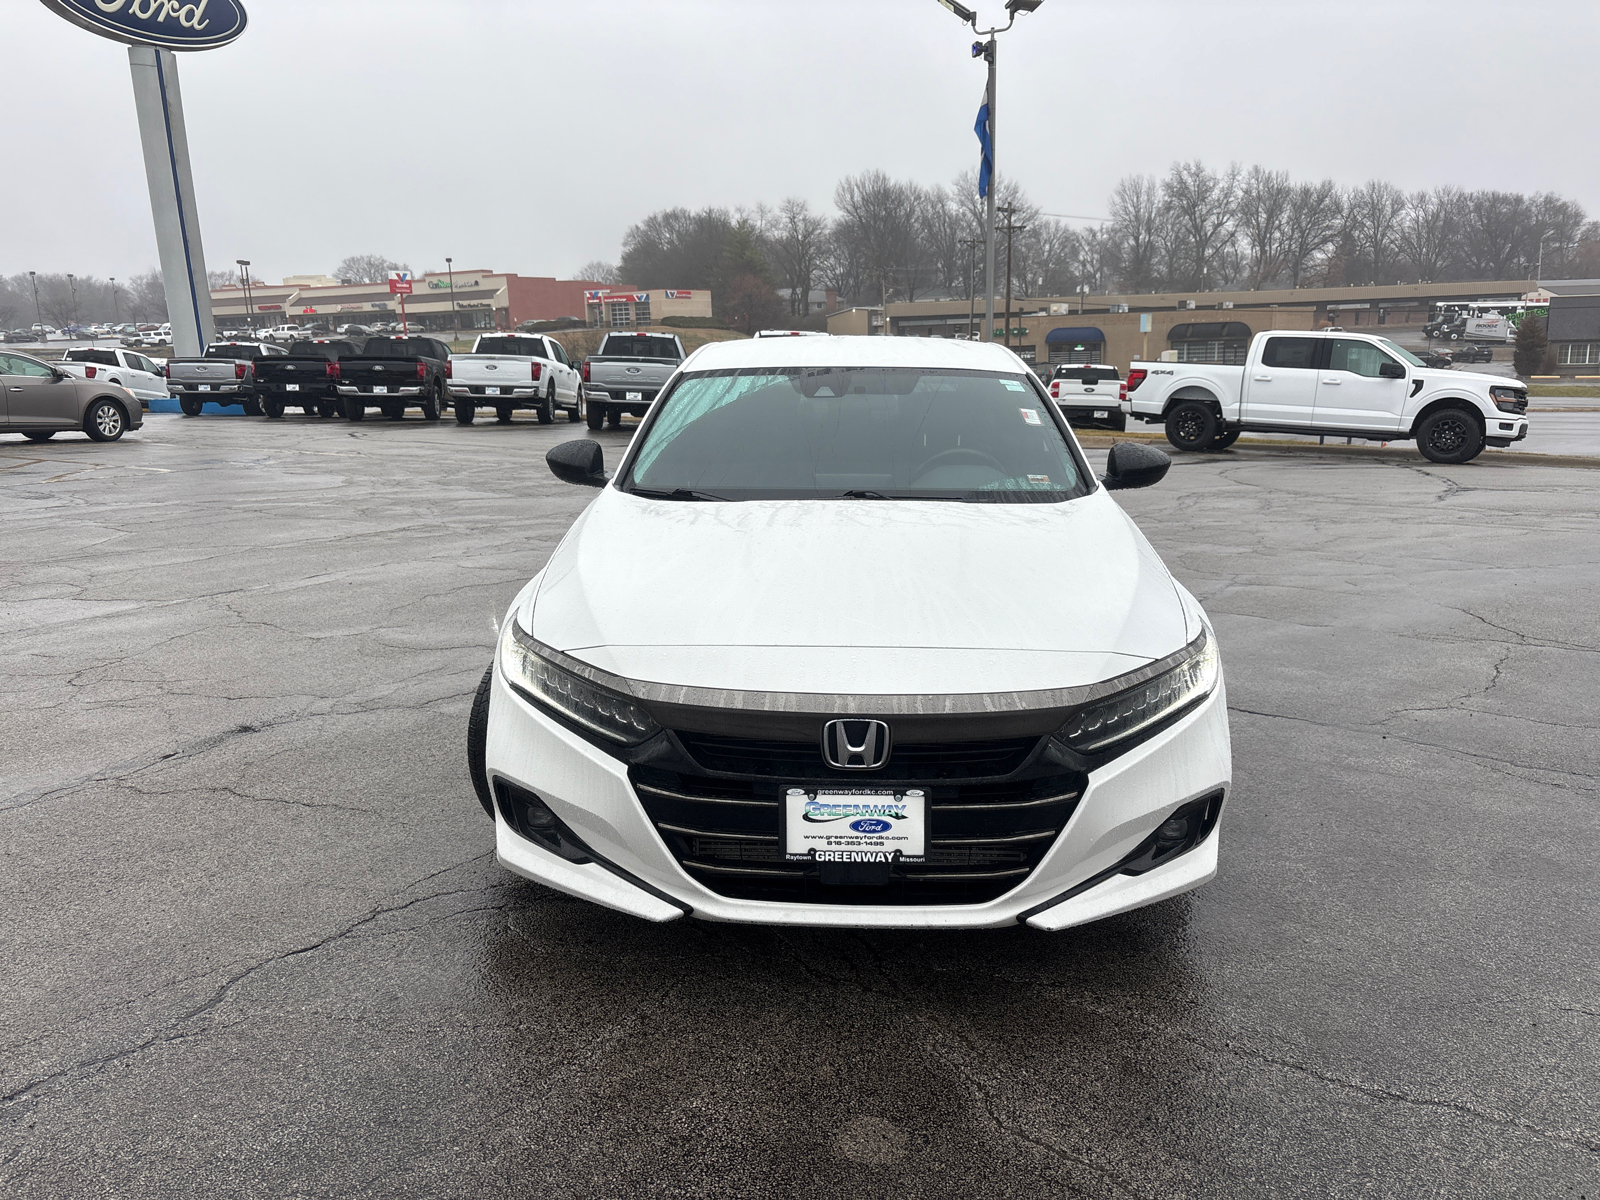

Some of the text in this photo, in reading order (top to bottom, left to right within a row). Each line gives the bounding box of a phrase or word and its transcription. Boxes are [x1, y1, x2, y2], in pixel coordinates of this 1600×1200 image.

[805, 801, 907, 817] GREENWAY
[858, 820, 884, 831] Ford
[785, 854, 812, 862] Raytown
[815, 850, 895, 863] GREENWAY
